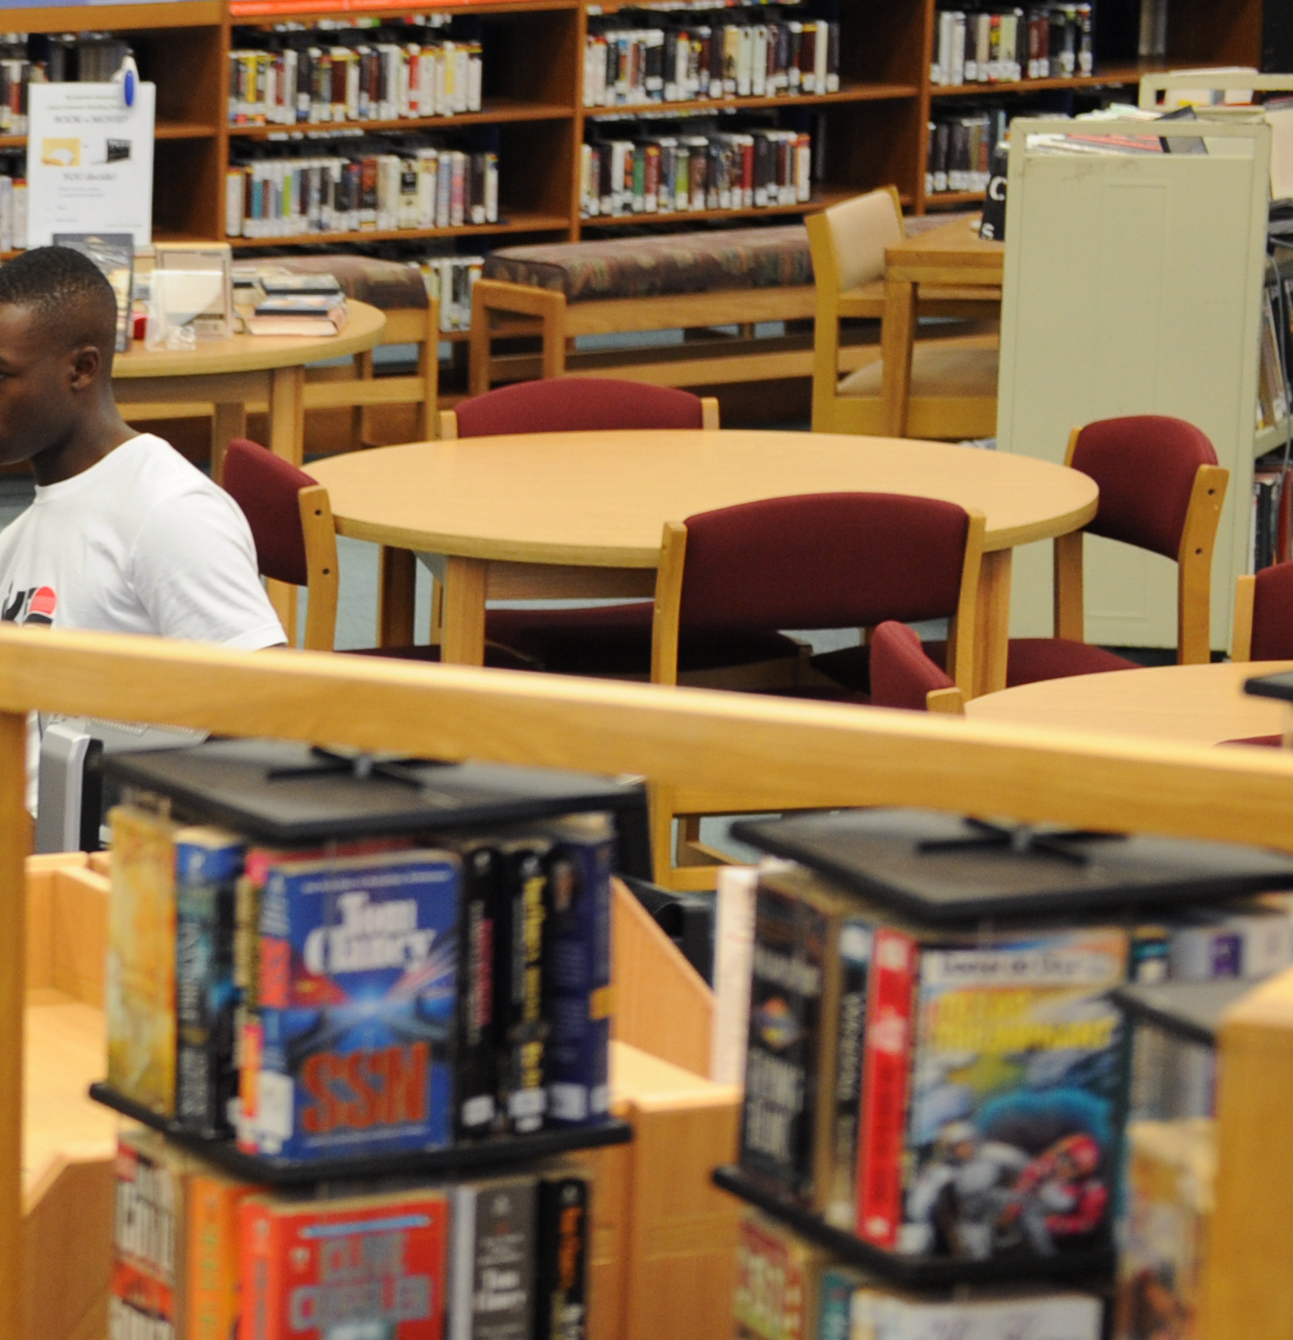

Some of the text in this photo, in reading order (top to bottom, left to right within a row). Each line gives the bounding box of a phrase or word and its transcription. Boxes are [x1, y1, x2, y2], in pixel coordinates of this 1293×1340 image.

[337, 890, 418, 937] Tom
[302, 928, 437, 977] Clancy
[300, 1041, 430, 1133] SSN
